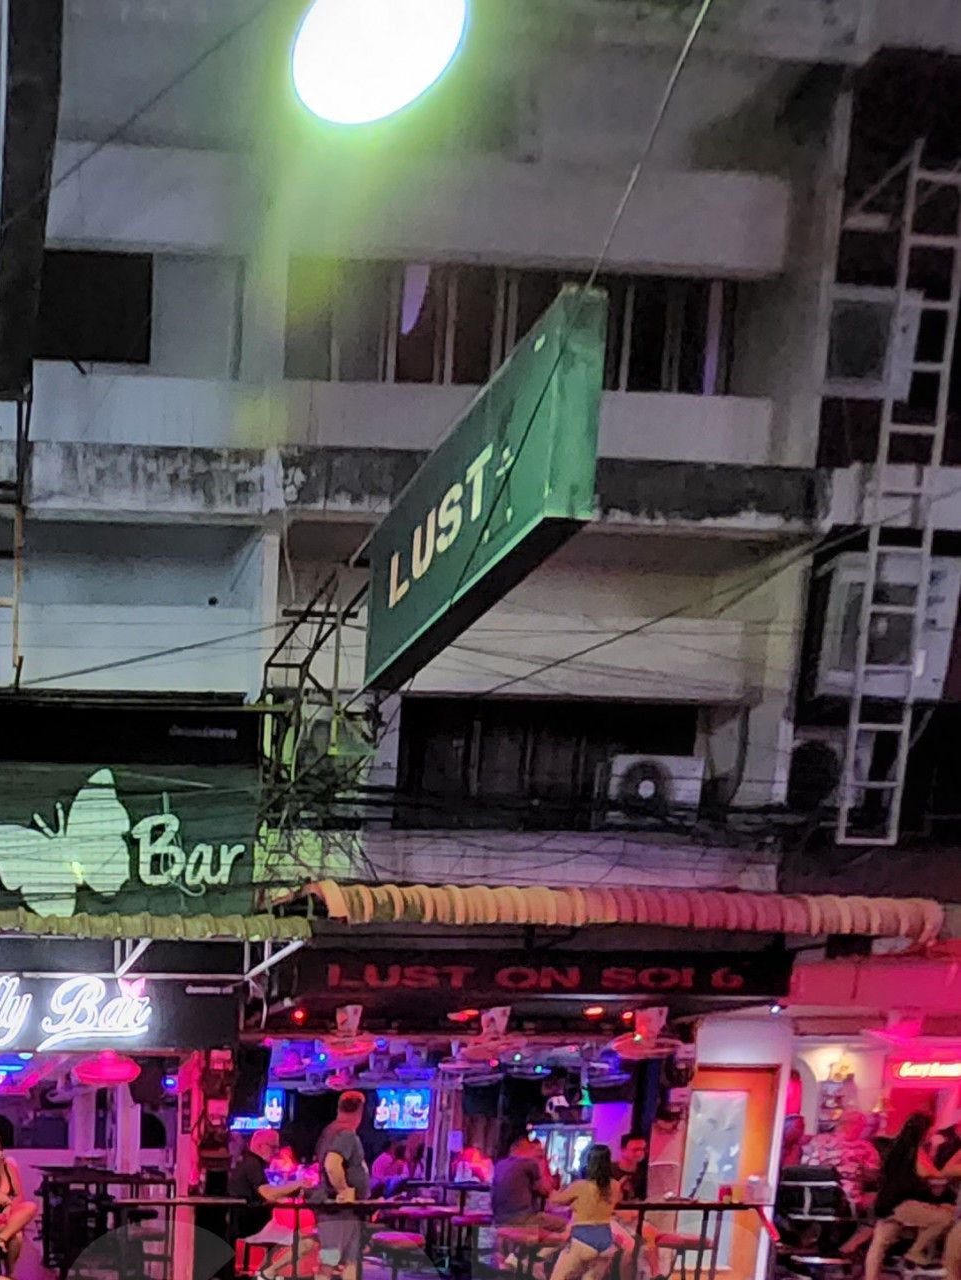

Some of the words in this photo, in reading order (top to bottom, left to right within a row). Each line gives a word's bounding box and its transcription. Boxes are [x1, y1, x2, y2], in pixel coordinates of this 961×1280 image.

[388, 444, 493, 608] LUST
[131, 812, 247, 896] Bar
[41, 975, 152, 1035] Bar
[327, 963, 476, 990] LUST
[495, 965, 580, 989] ON
[601, 966, 693, 990] SOI
